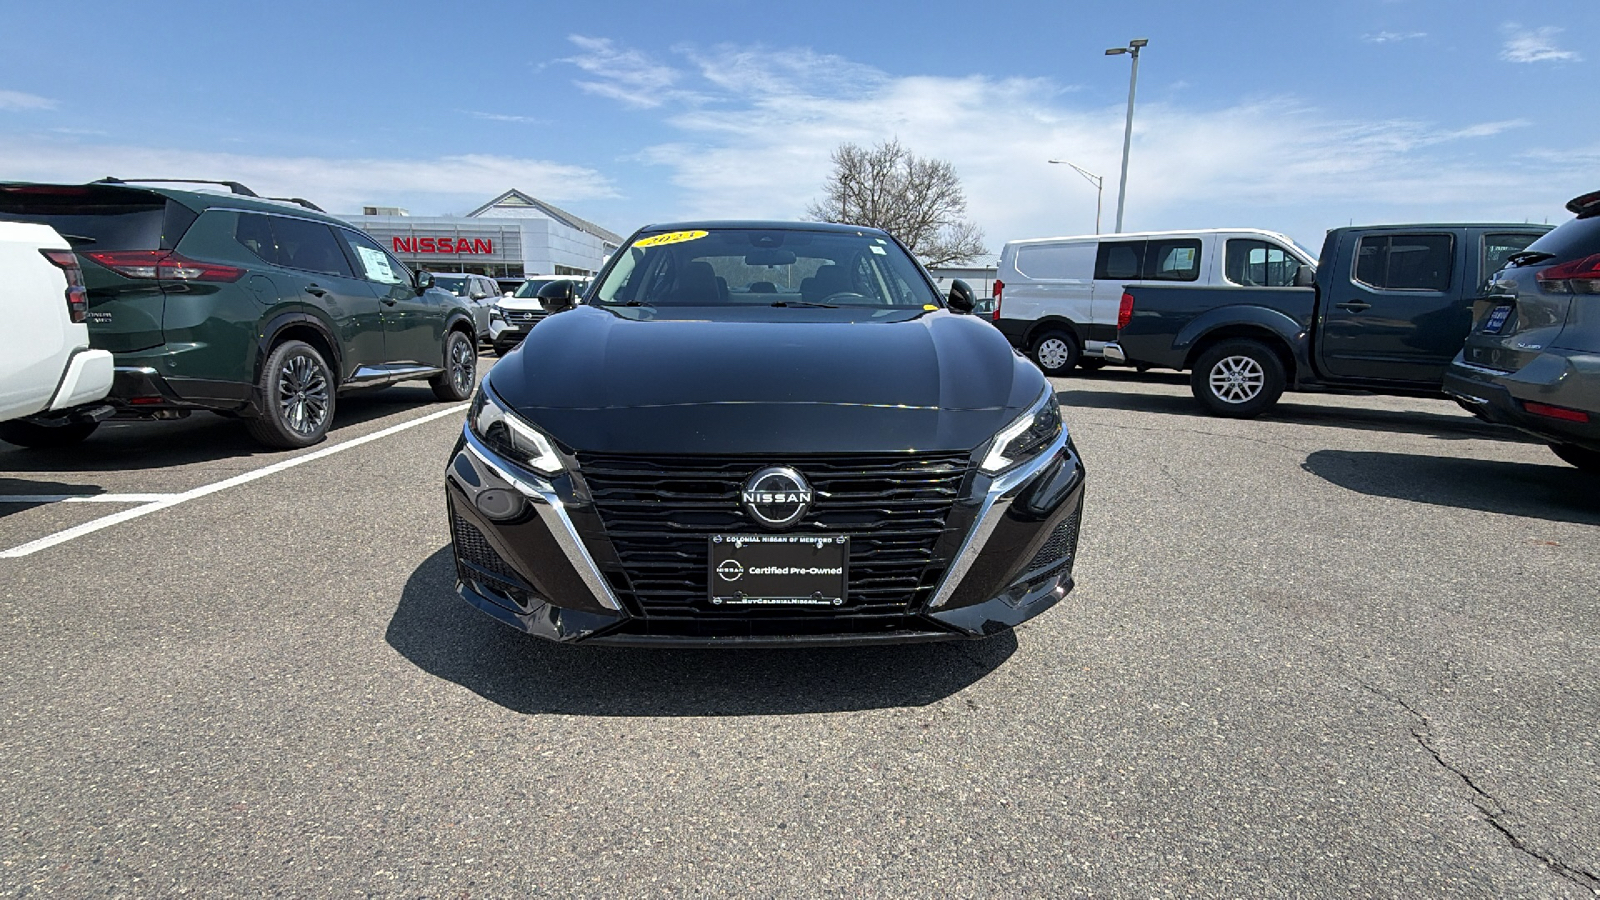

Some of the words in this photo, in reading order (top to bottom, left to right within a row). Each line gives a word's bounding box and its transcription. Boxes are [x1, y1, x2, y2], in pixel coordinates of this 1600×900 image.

[392, 236, 493, 254] NISSAN
[743, 492, 811, 503] NISSAN
[749, 566, 789, 575] Certified
[790, 566, 843, 575] Pre-Owned
